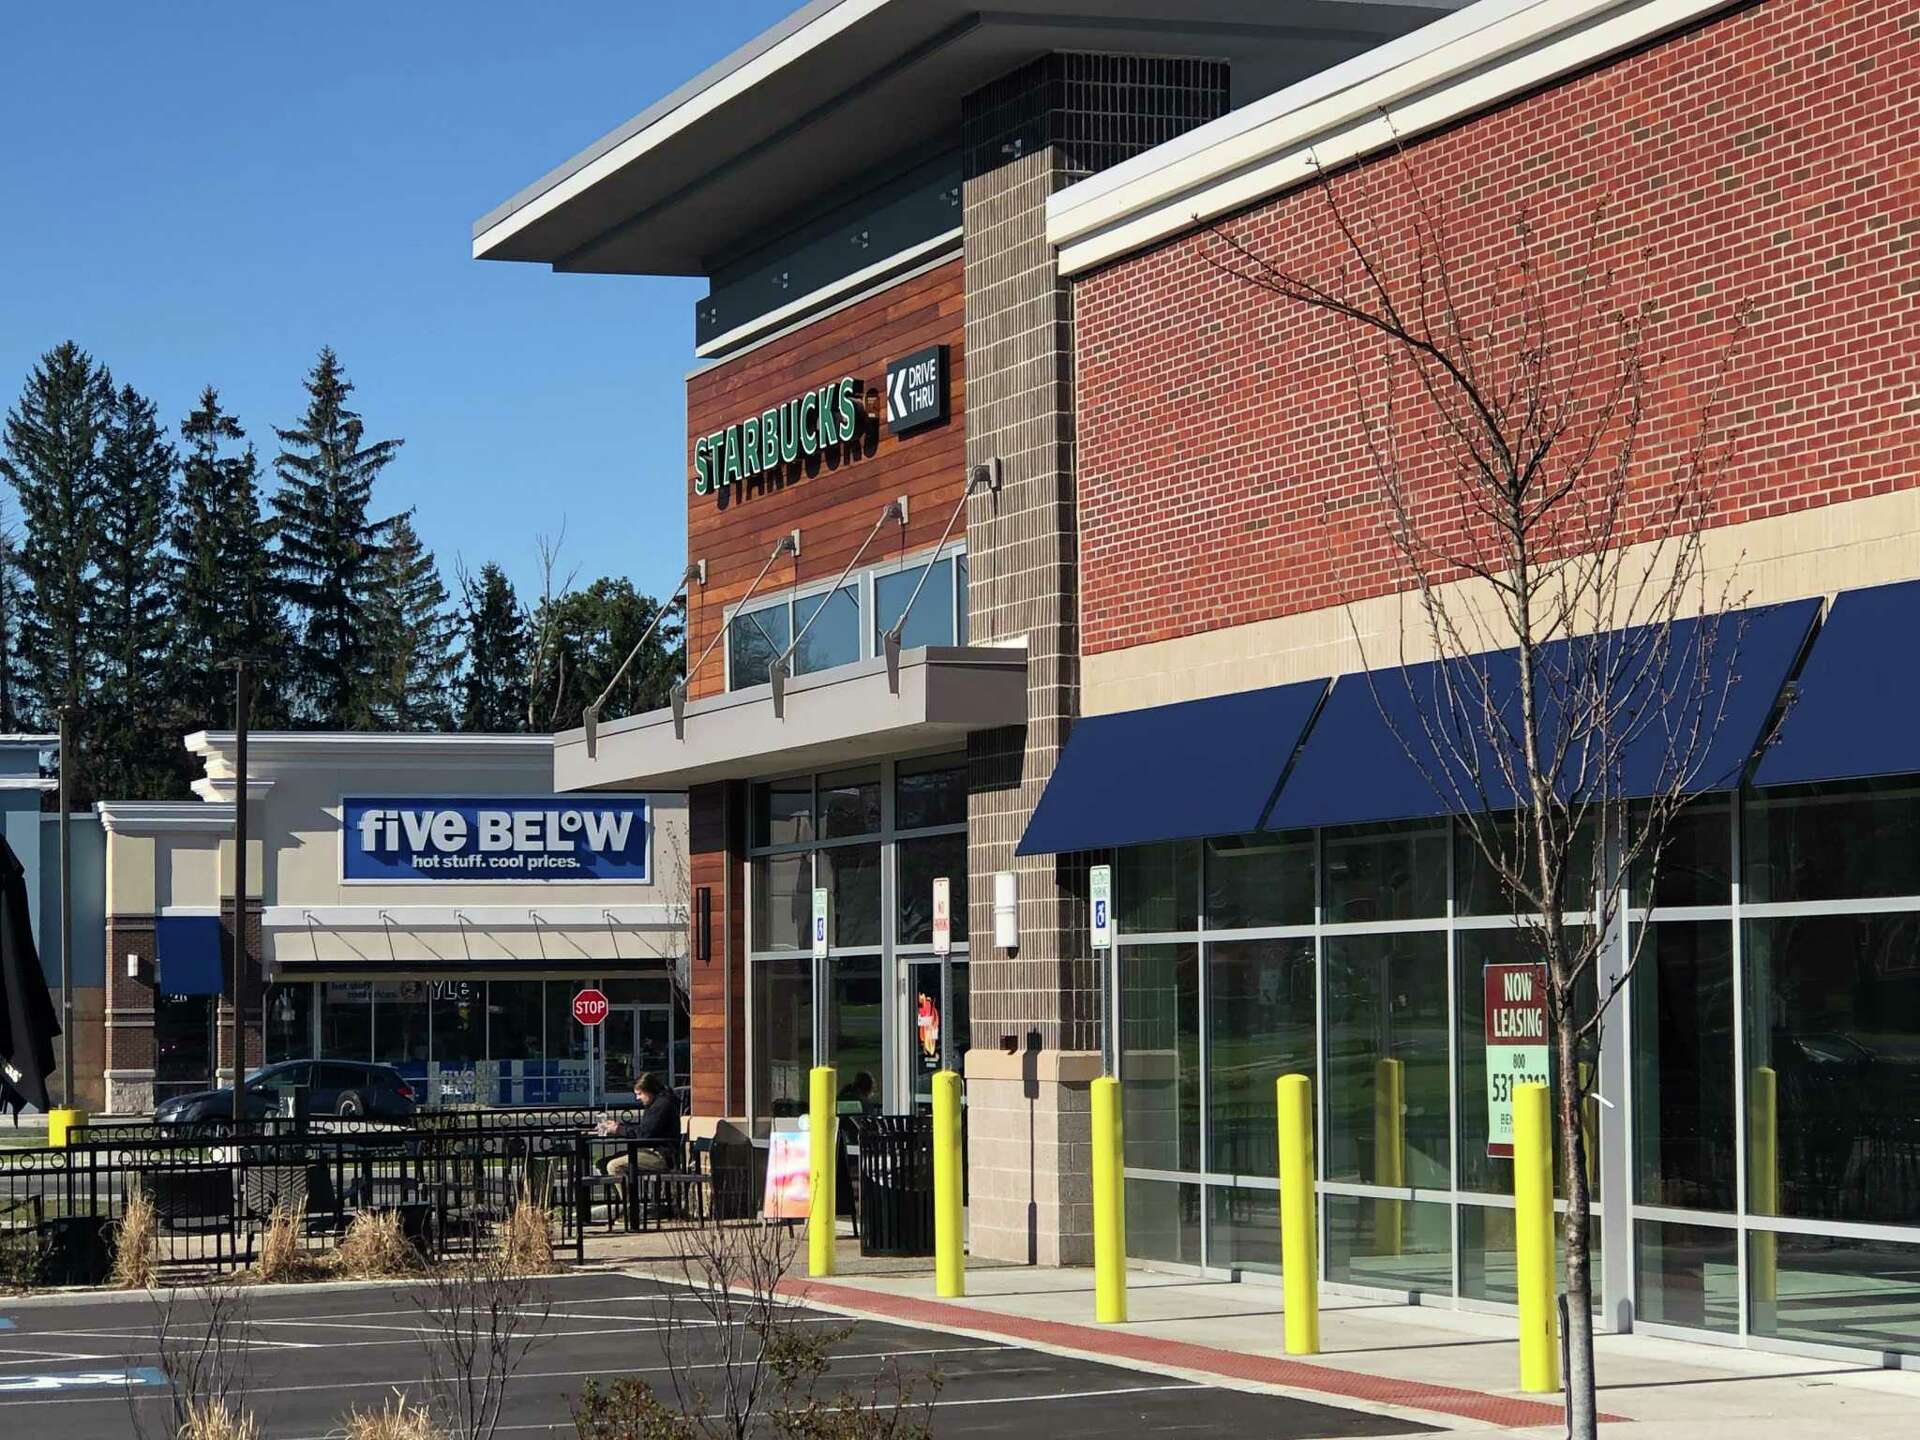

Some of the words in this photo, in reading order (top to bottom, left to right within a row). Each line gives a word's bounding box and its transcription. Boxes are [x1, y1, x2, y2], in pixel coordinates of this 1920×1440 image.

[908, 358, 936, 389] DRIVE
[908, 384, 935, 414] THRU
[694, 376, 855, 496] STARBUCKS
[357, 809, 467, 852] five
[412, 854, 440, 869] hot
[443, 854, 486, 869] stuff.
[488, 854, 523, 869] cool
[527, 854, 581, 871] prices.
[1503, 972, 1532, 1002] NOW
[576, 1001, 605, 1015] STOP
[1493, 1008, 1542, 1038] LEASING
